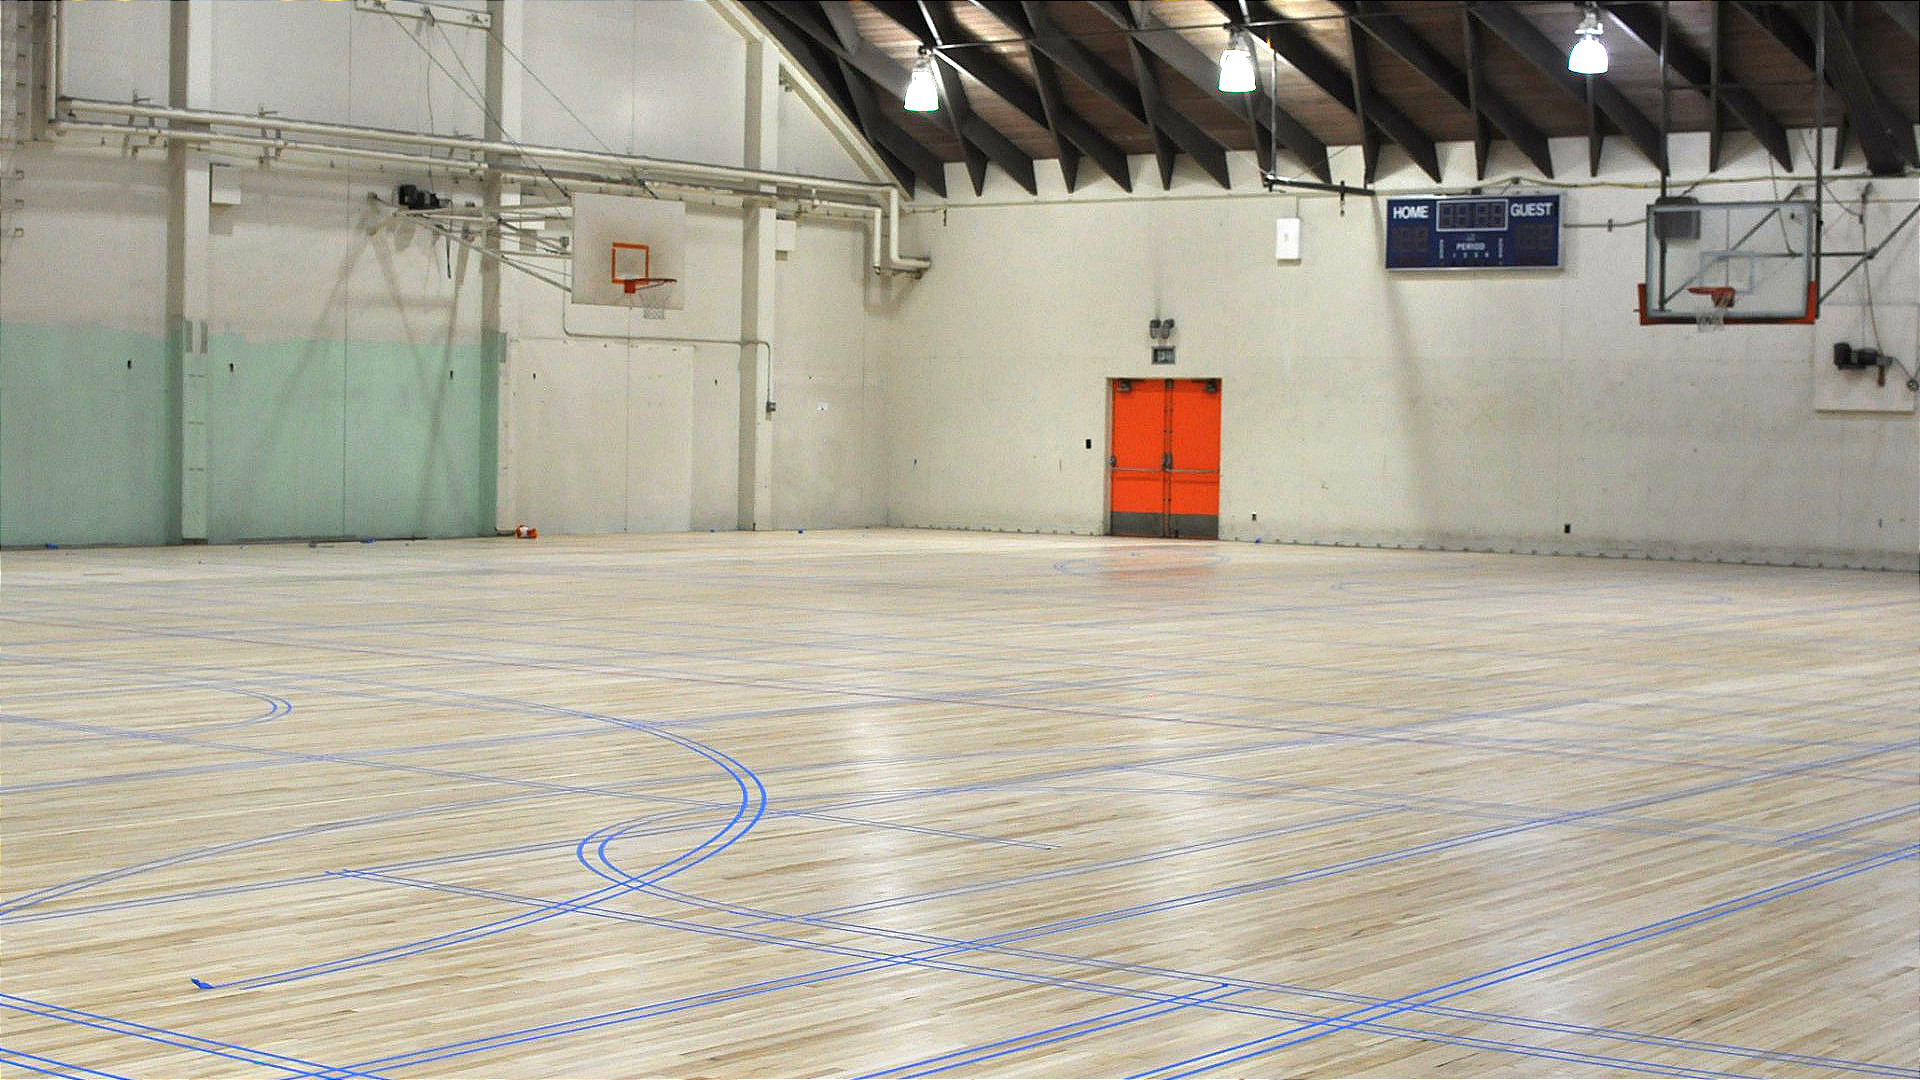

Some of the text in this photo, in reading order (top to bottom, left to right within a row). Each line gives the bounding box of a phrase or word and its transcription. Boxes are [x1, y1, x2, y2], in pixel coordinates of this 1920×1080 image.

[1393, 206, 1429, 219] HOME
[1511, 202, 1553, 217] GUEST
[1456, 243, 1486, 251] PERIOD
